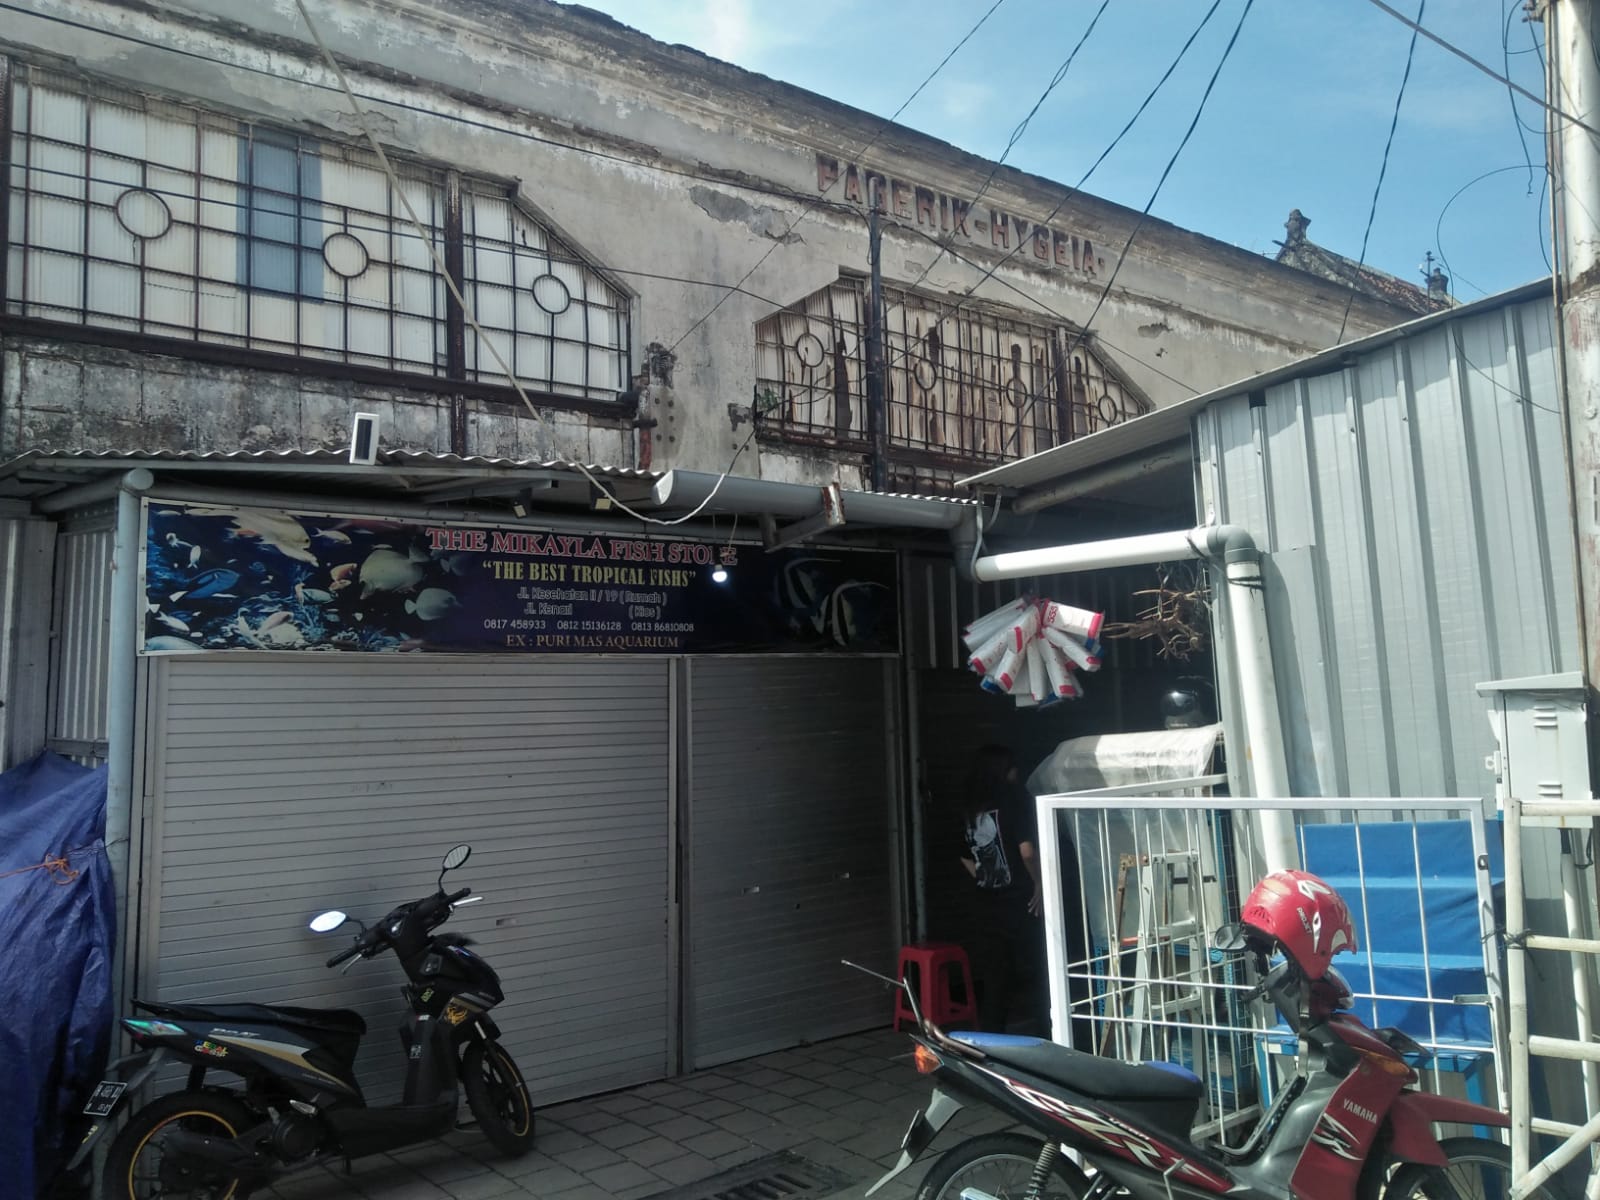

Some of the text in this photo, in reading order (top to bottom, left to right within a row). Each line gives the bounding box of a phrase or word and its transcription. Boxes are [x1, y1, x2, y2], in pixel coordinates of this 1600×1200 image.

[426, 528, 488, 550] THE
[491, 532, 608, 558] MIKAYLA
[610, 540, 665, 562] FISH
[529, 562, 569, 582] BEST
[572, 565, 645, 585] TROPICAL
[531, 587, 589, 602] Kesehatan
[538, 603, 574, 616] Kenari
[483, 618, 546, 631] 0817 458933
[557, 620, 622, 632] 0812 15136128
[631, 622, 652, 632] 0813
[506, 634, 526, 647] EX
[536, 634, 570, 648] PURI
[573, 635, 603, 648] MAS
[606, 635, 679, 650] AQUARIUM
[1343, 1098, 1378, 1125] YAMAHA
